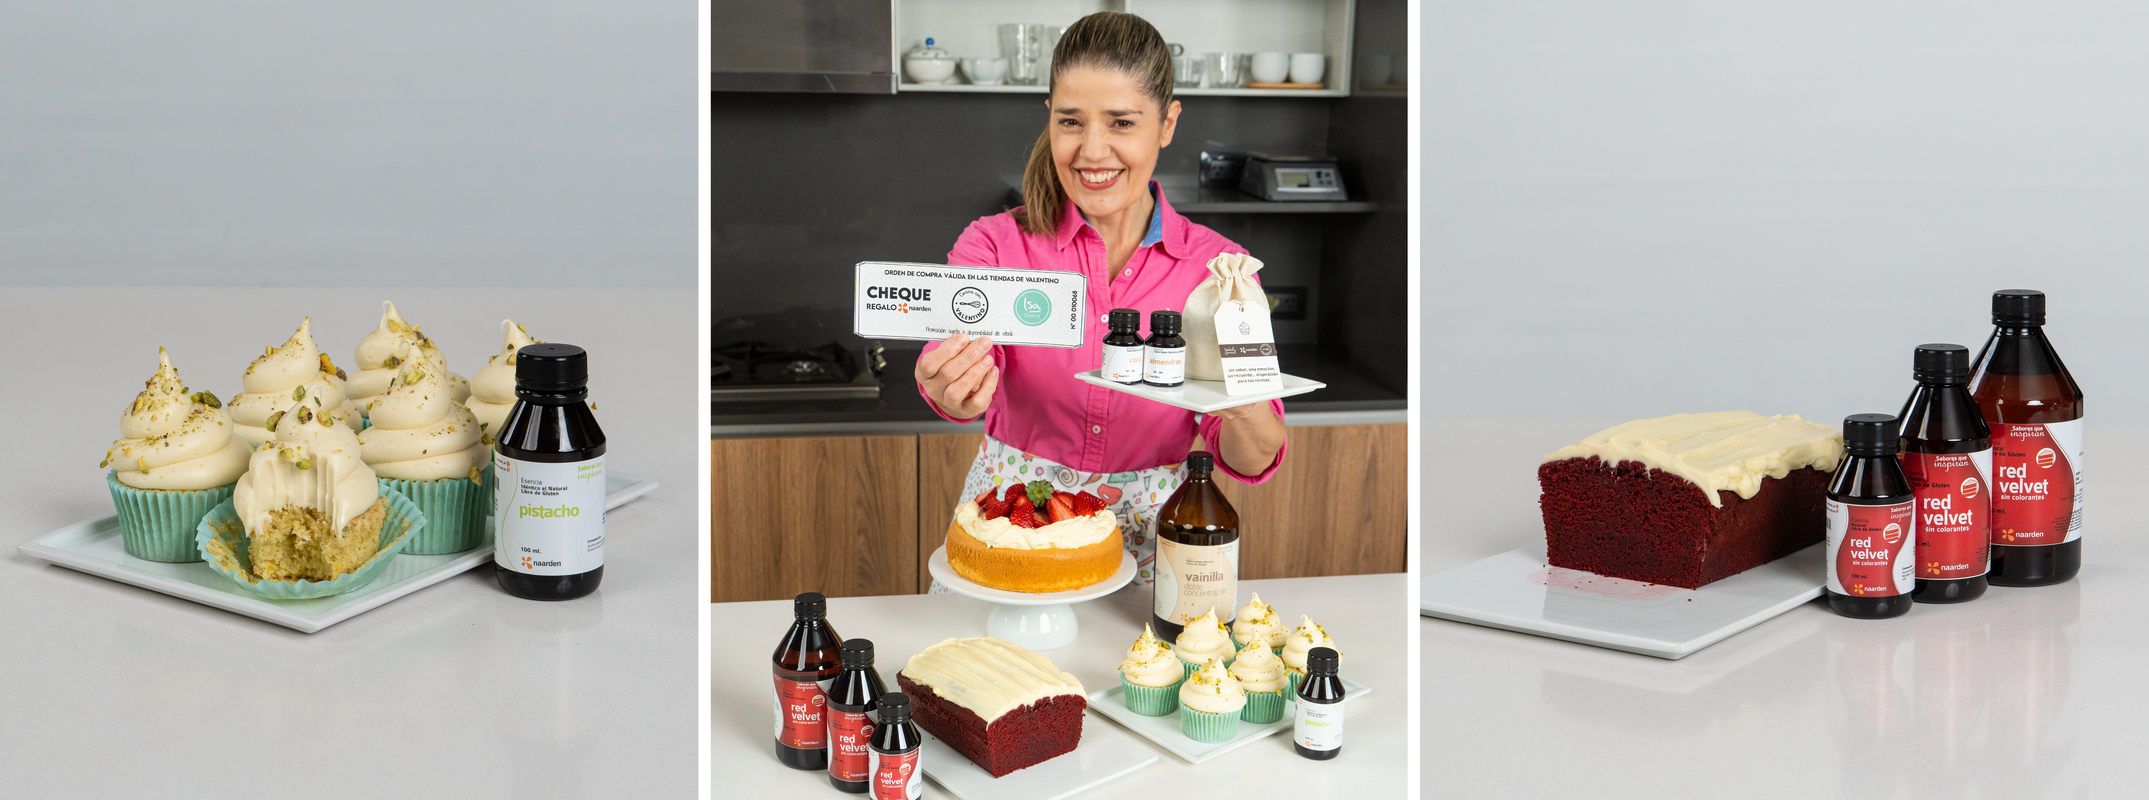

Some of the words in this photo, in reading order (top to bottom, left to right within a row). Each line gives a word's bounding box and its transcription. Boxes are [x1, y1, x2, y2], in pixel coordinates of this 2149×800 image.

[944, 271, 966, 280] VÁLIDA
[866, 285, 931, 302] CHEQUE
[866, 303, 897, 311] REGALO
[1023, 296, 1042, 312] Isa
[955, 307, 985, 321] VALENTINO
[1070, 312, 1077, 322] 00
[1149, 358, 1182, 366] almendras
[2010, 430, 2045, 441] inspiran
[577, 463, 596, 472] Sabores
[1934, 461, 1969, 472] inspiran
[1999, 462, 2027, 478] red
[520, 477, 543, 485] Esencia
[1999, 478, 2049, 495] velvet
[1923, 493, 1951, 510] red
[519, 503, 580, 519] pistacho
[1923, 509, 1973, 526] velvet
[1850, 536, 1871, 548] red
[1850, 548, 1889, 560] velvet
[533, 559, 562, 567] naarden
[1941, 563, 1969, 571] naarden
[1185, 571, 1224, 582] vainilla
[1183, 582, 1203, 591] doble
[1183, 587, 1227, 597] concentración
[791, 703, 806, 712] red
[791, 710, 821, 721] velvet
[1305, 719, 1332, 728] pistacho
[839, 734, 856, 743] red
[839, 743, 870, 752] velvet
[880, 771, 893, 779] red
